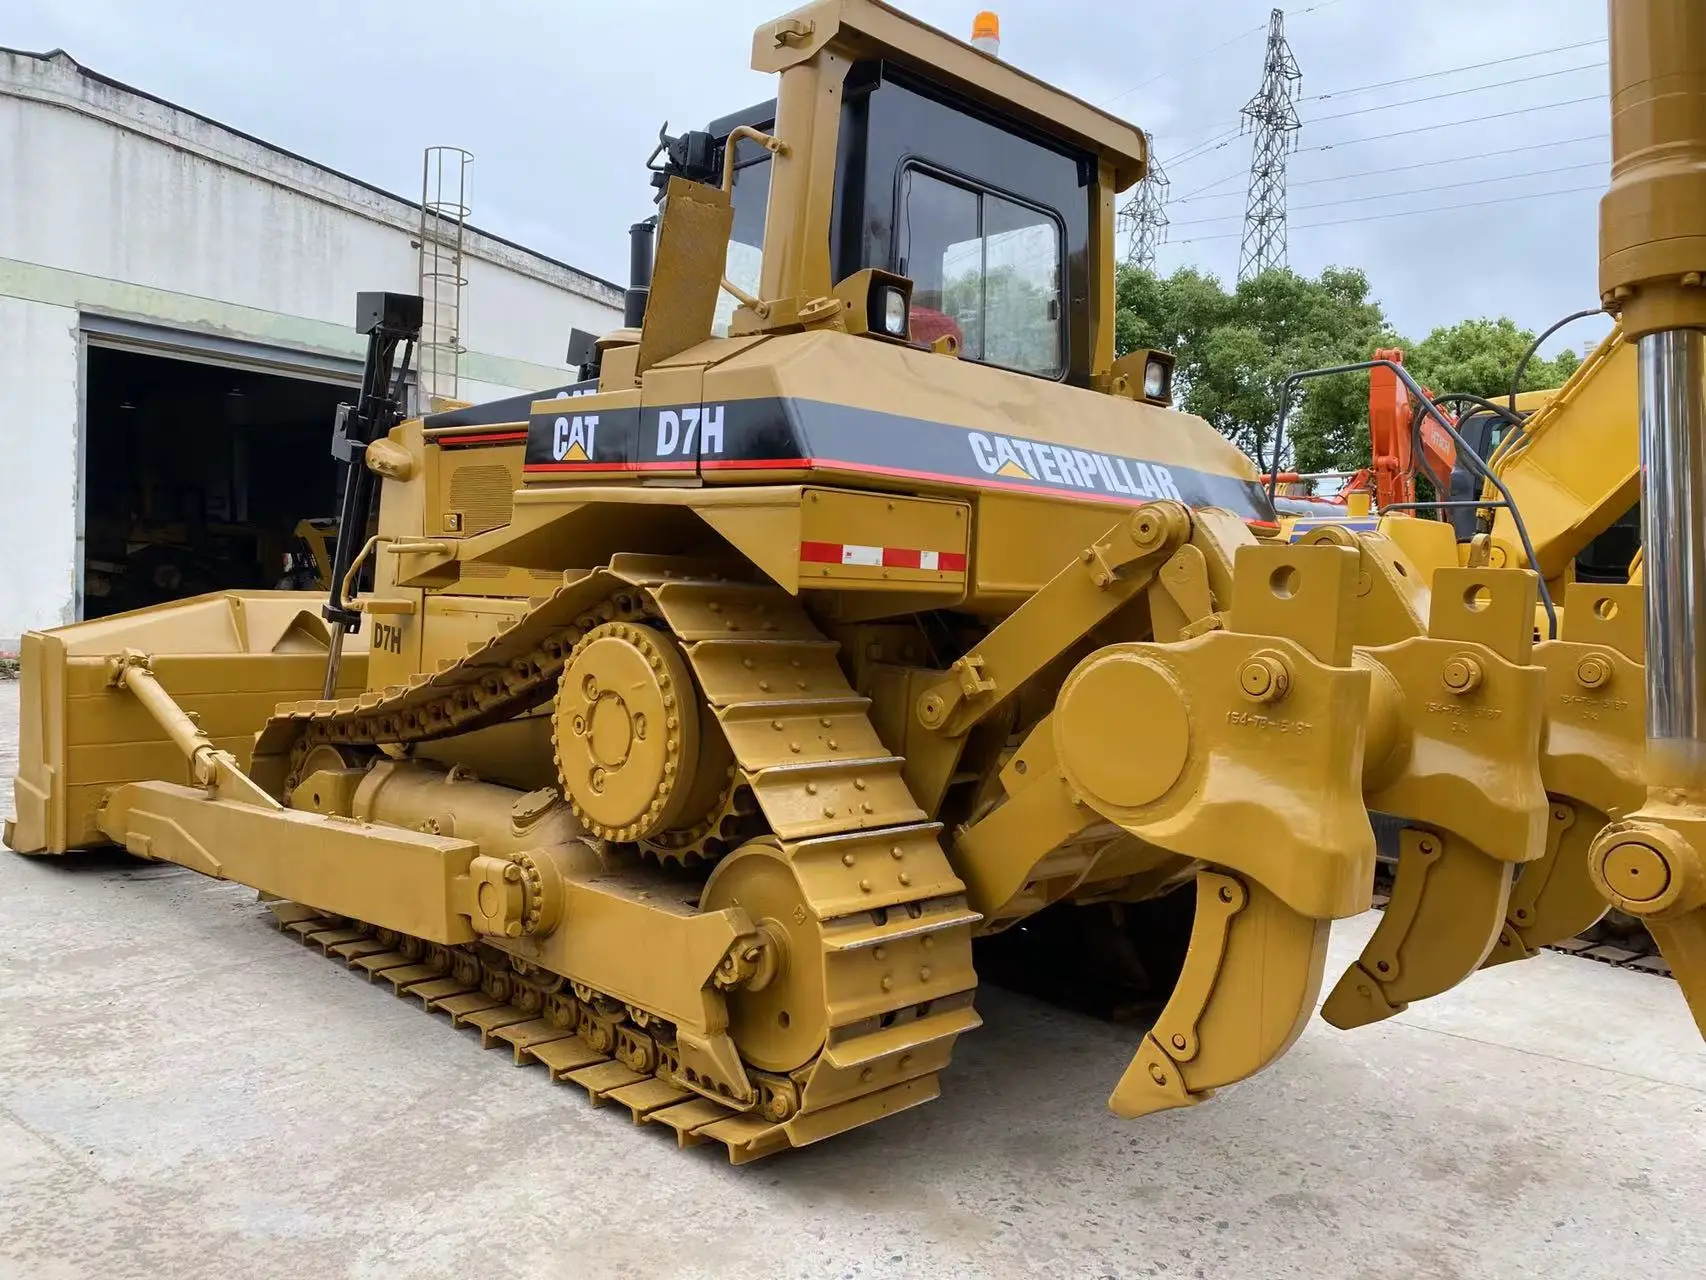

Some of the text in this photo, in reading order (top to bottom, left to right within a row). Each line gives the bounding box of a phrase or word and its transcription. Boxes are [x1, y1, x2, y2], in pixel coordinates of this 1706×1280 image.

[553, 415, 599, 461] CAT
[656, 406, 725, 456] D7H
[968, 432, 1183, 502] CATERPILLAR
[374, 622, 402, 654] D7H
